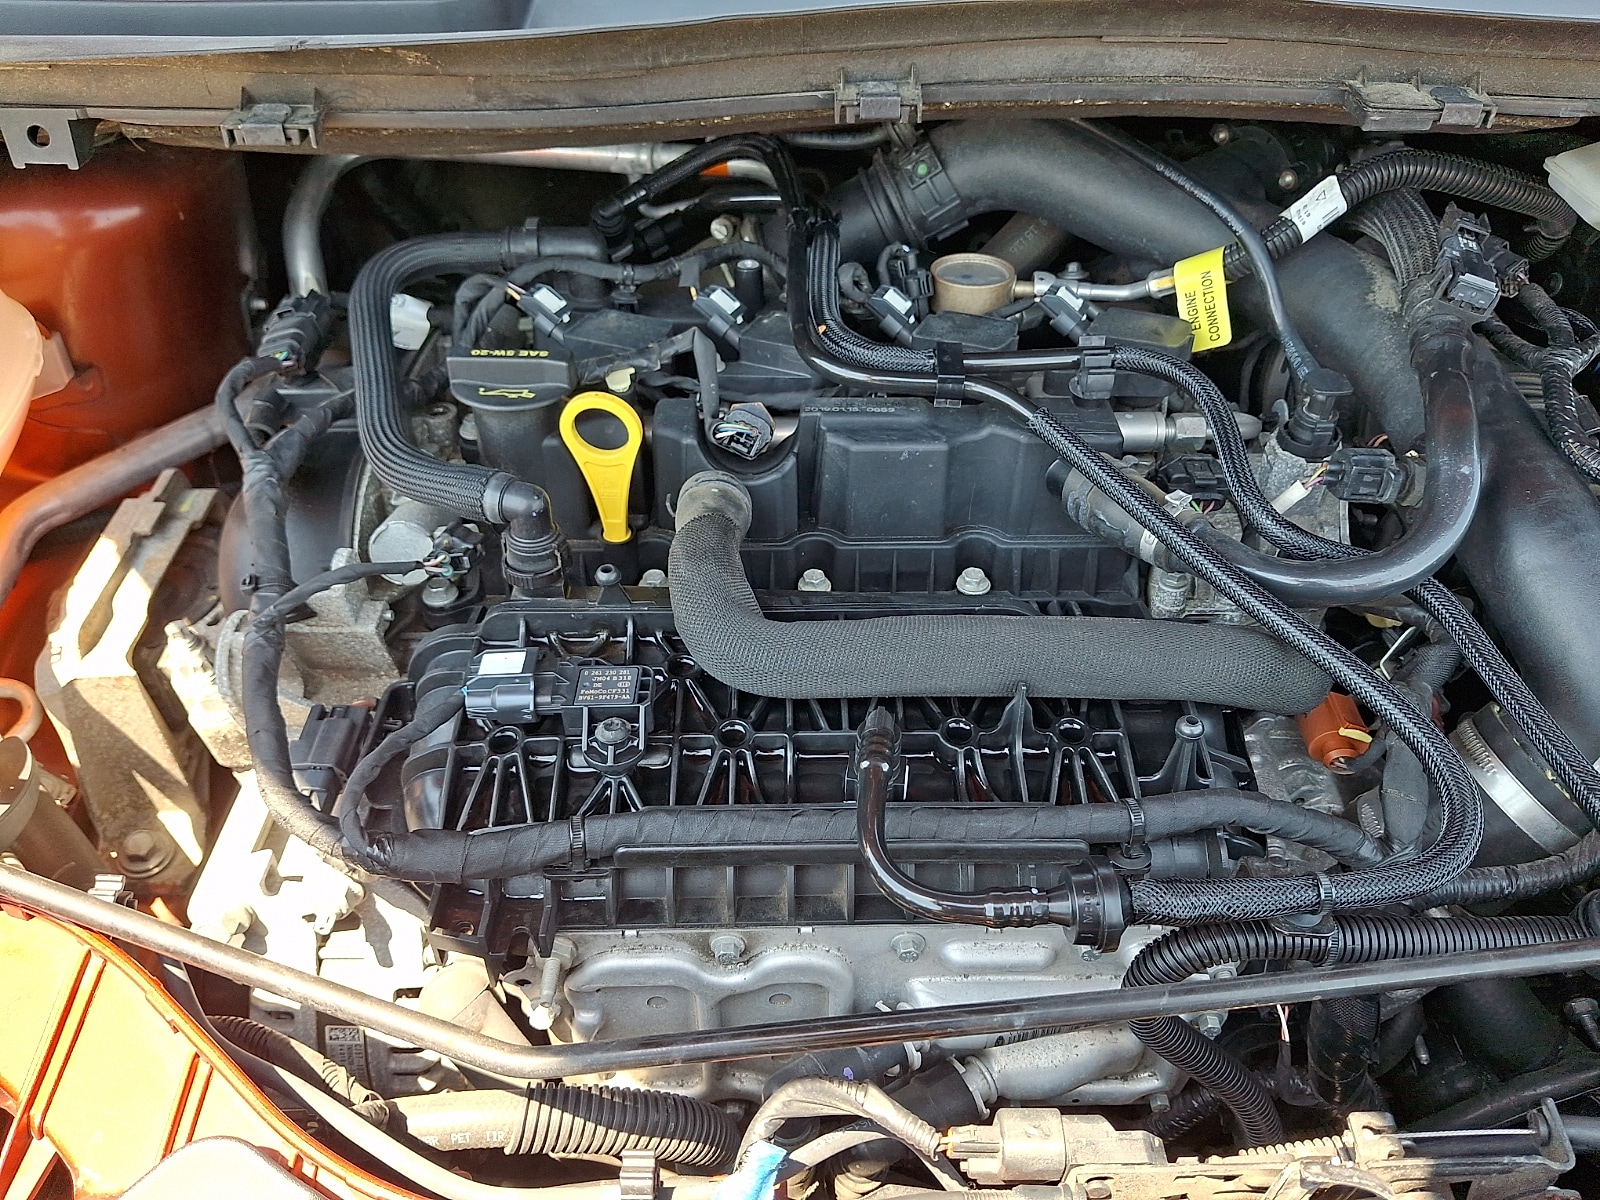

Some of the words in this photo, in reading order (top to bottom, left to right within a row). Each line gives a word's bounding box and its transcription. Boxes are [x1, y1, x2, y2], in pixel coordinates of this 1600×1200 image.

[1185, 290, 1202, 332] ENGINE
[1200, 270, 1221, 342] CONNECTION
[470, 349, 516, 357] 5W-20
[518, 349, 550, 357] SAE
[450, 1131, 472, 1145] PET
